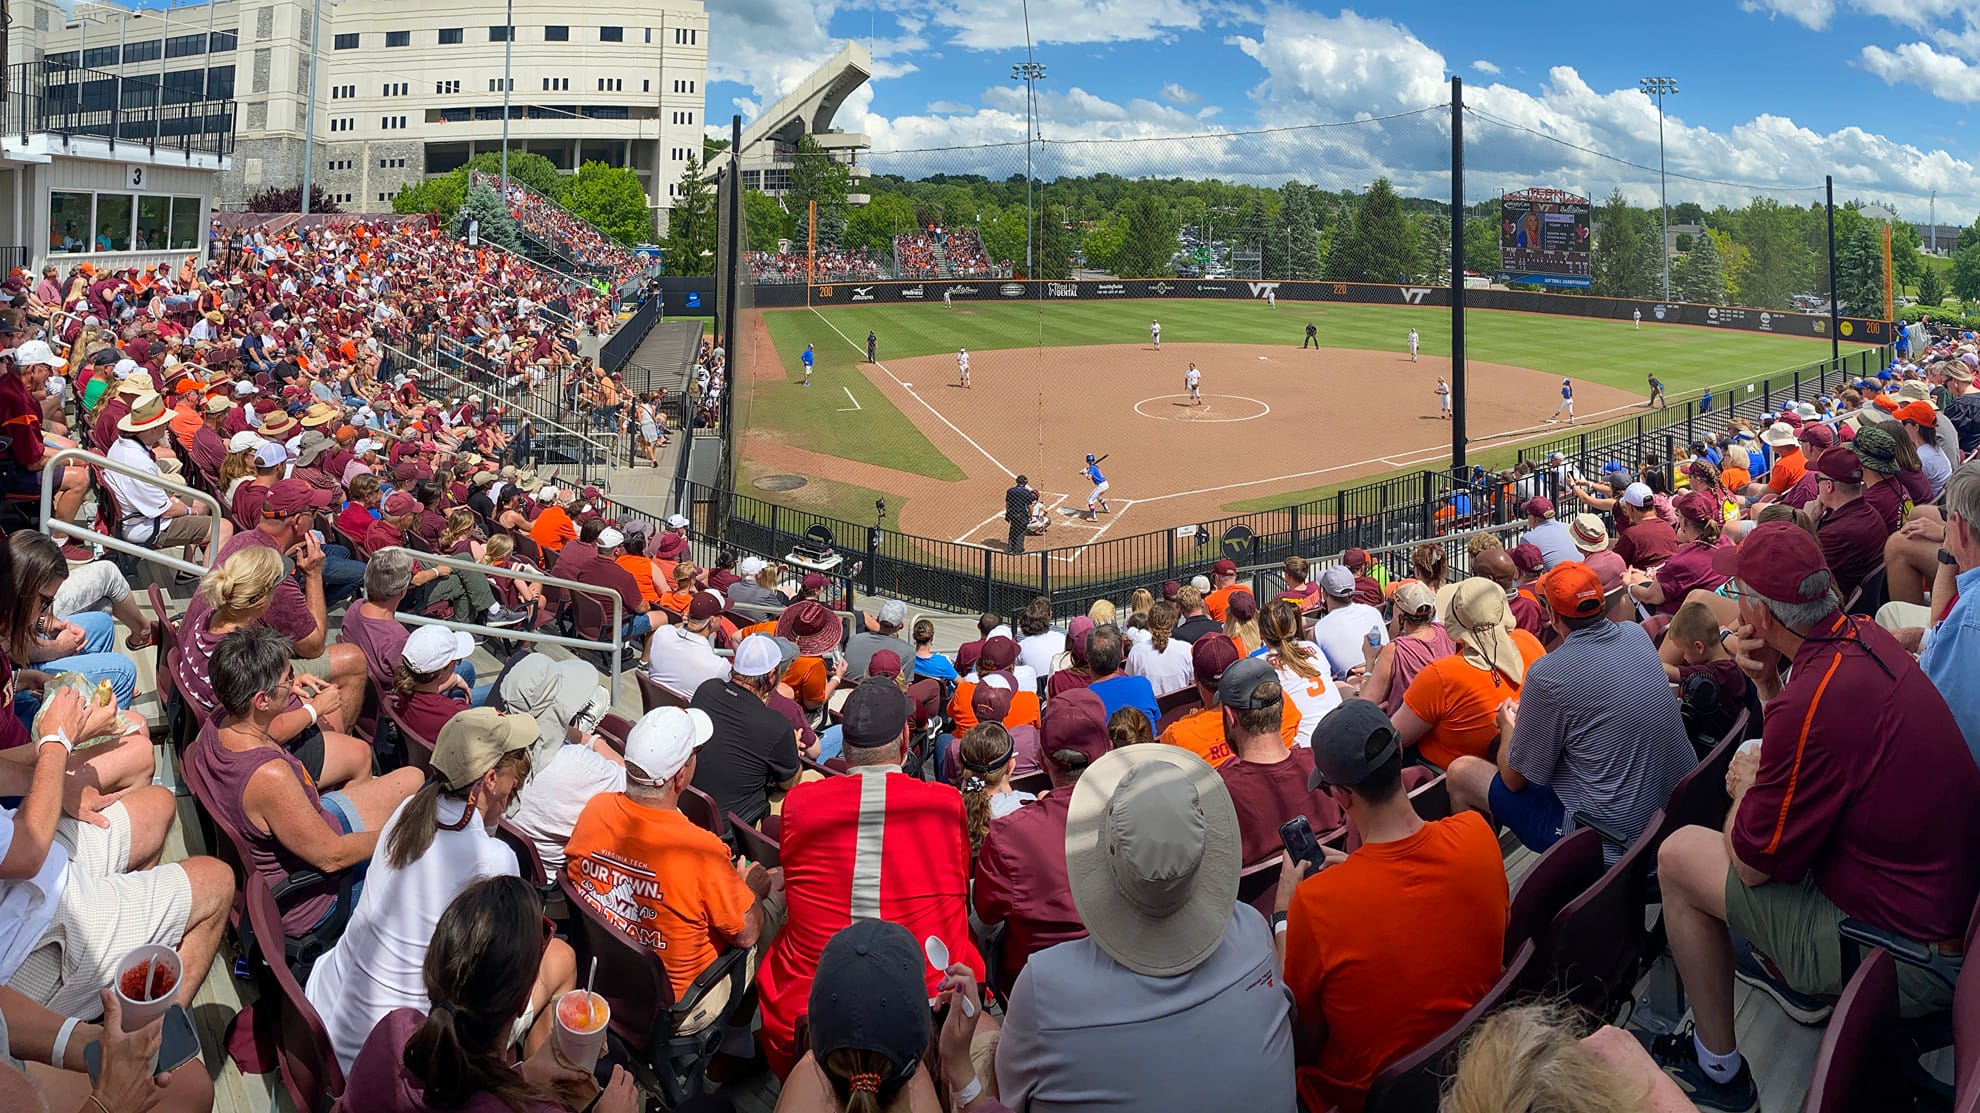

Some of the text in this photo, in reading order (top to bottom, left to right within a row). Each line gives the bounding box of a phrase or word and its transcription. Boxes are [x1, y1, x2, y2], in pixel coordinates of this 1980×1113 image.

[133, 168, 142, 185] 3
[820, 286, 833, 297] 200
[1248, 282, 1280, 298] VT
[1334, 283, 1347, 294] 220
[1400, 287, 1432, 304] VT
[1866, 321, 1880, 334] 200
[601, 849, 627, 862] VIRGINIA
[581, 859, 609, 883] OUR
[612, 870, 663, 900] TOWN.
